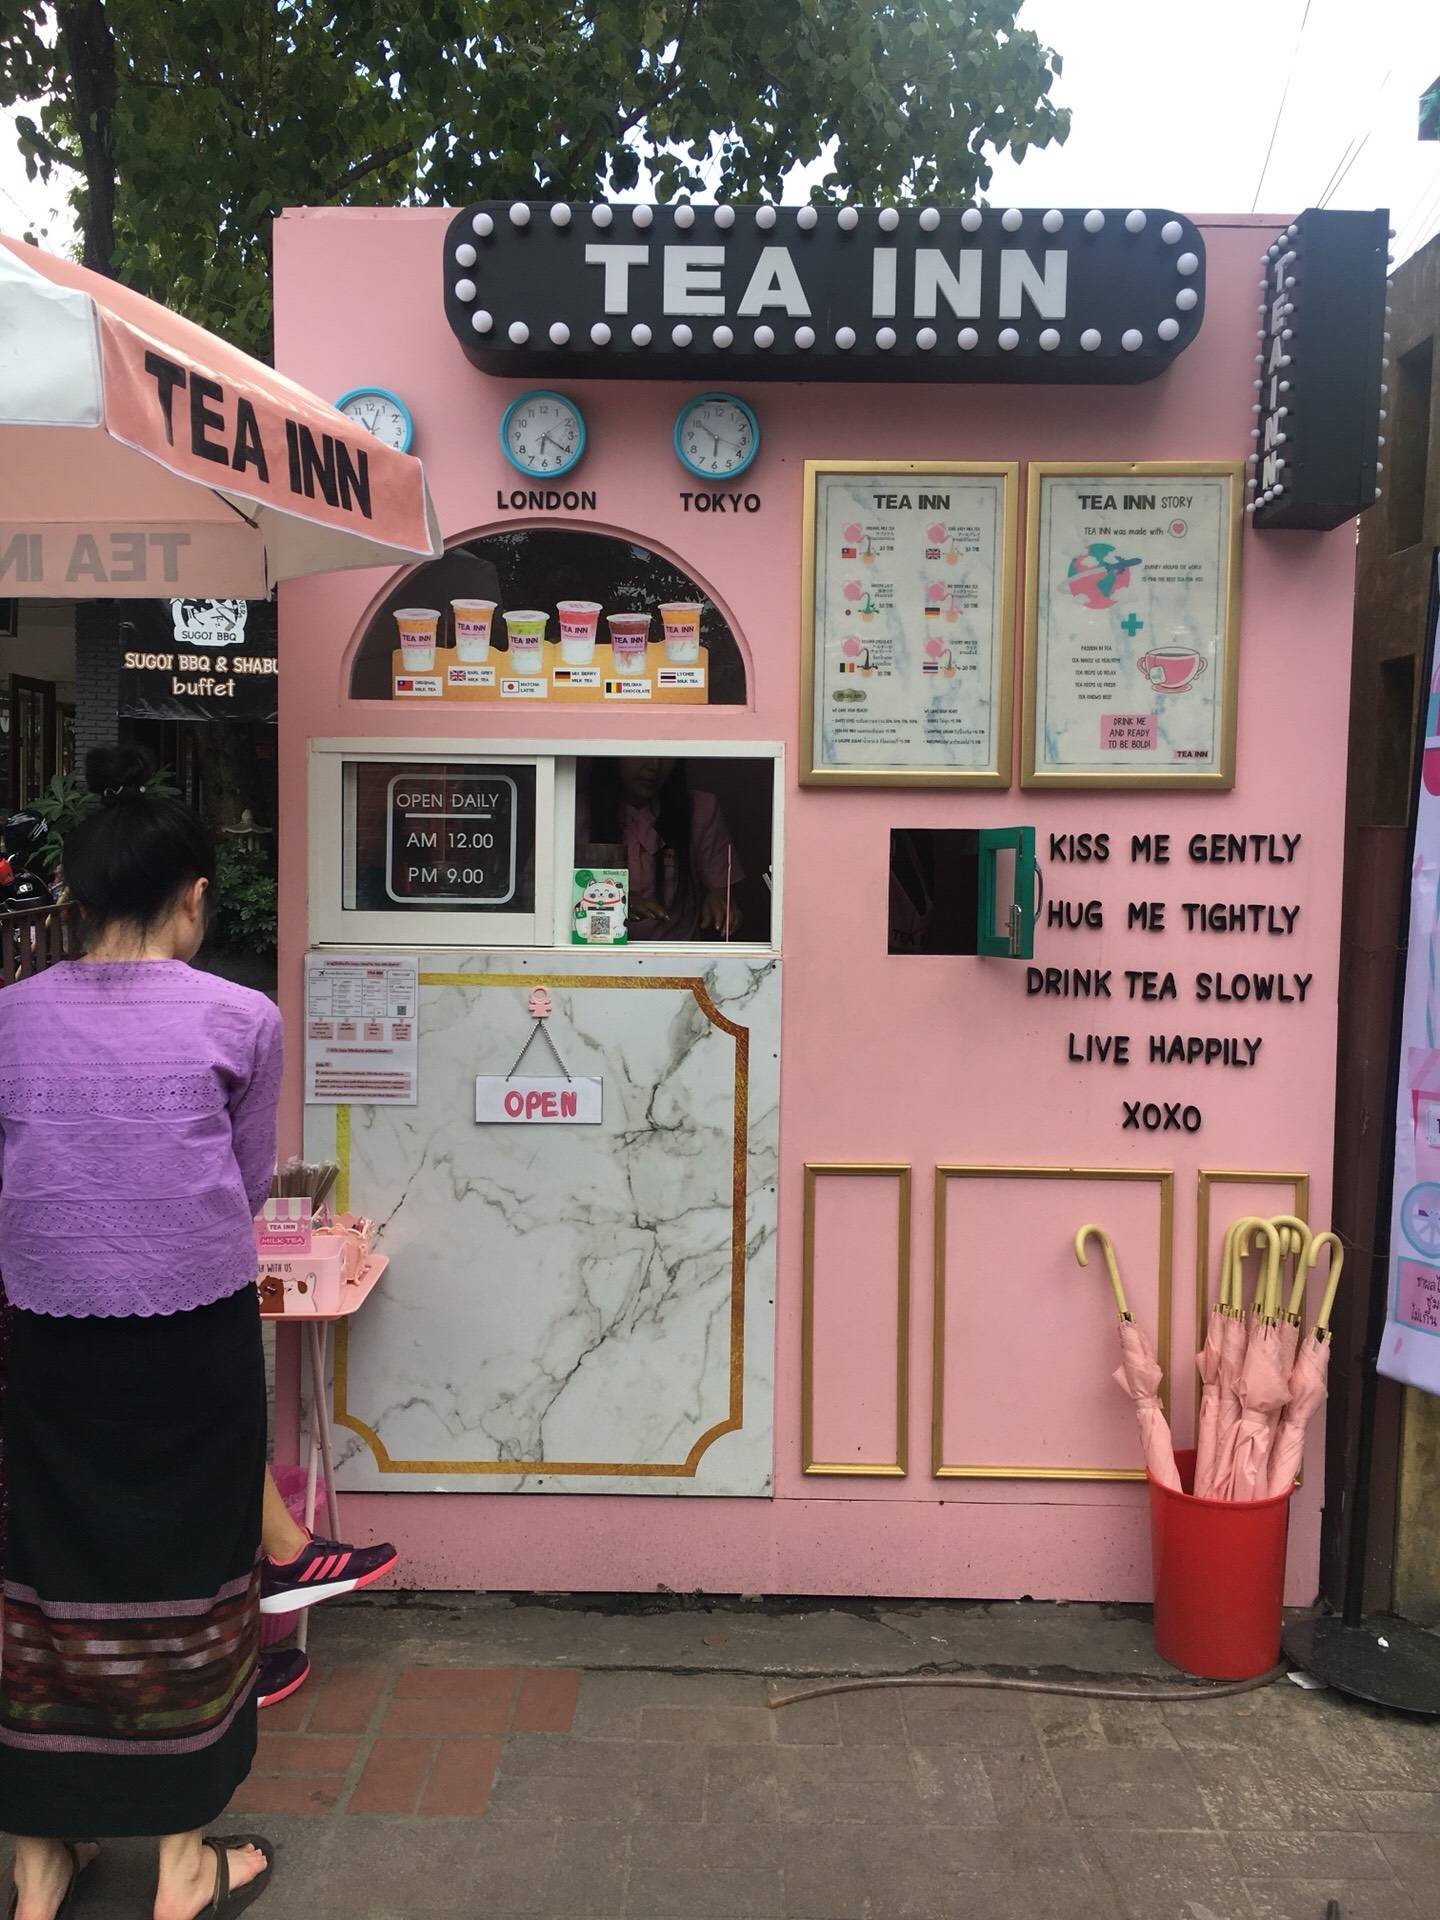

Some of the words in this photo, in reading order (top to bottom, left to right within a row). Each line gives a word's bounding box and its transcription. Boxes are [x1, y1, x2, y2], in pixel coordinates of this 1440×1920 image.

[585, 244, 812, 317] TEA
[872, 247, 1068, 320] INN
[145, 350, 269, 483] TEA
[285, 418, 372, 520] INN
[497, 490, 596, 510] LONDON
[680, 493, 761, 513] TOKYO
[873, 494, 912, 509] TEA
[918, 494, 950, 510] INN
[1078, 495, 1117, 510] TEA
[1123, 495, 1156, 510] INN
[1161, 496, 1193, 509] STORY
[1084, 527, 1097, 535] TEA
[1099, 527, 1111, 535] INN
[1128, 527, 1147, 535] made
[1149, 527, 1164, 536] with
[457, 623, 470, 631] TEA
[561, 625, 573, 633] TEA
[575, 626, 588, 634] INN
[181, 630, 212, 640] SUGOI
[217, 632, 237, 641] BBQ
[402, 634, 416, 642] TEA
[419, 634, 431, 642] INN
[510, 636, 524, 644] TEA
[614, 636, 628, 644] TEA
[630, 636, 643, 644] INN
[124, 652, 173, 671] SUGOI
[178, 654, 211, 673] BBQ
[215, 656, 228, 672] &
[172, 676, 236, 697] buffet
[1110, 729, 1124, 737] AND
[1128, 729, 1149, 737] READY
[1108, 740, 1116, 748] TO
[1119, 740, 1129, 748] BE
[397, 794, 442, 807] OPEN
[452, 794, 499, 807] DAILY
[406, 833, 437, 847] AM
[448, 833, 493, 848] 12.00
[1050, 833, 1110, 863] KISS
[1131, 834, 1170, 863] ME
[1188, 834, 1301, 863] GENTLY
[408, 867, 437, 883] PM
[447, 868, 483, 883] 9.00
[1048, 900, 1103, 929] HUG
[1128, 901, 1165, 930] ME
[1182, 902, 1300, 934] TIGHTLY
[1027, 967, 1112, 998] DRINK
[1125, 970, 1177, 1000] TEA
[1195, 972, 1313, 1001] SLOWLY
[1069, 1032, 1130, 1063] LIVE
[1149, 1034, 1262, 1066] HAPPILY
[504, 1090, 577, 1119] OPEN
[1122, 1101, 1201, 1132] XOXO
[284, 1263, 292, 1273] US
